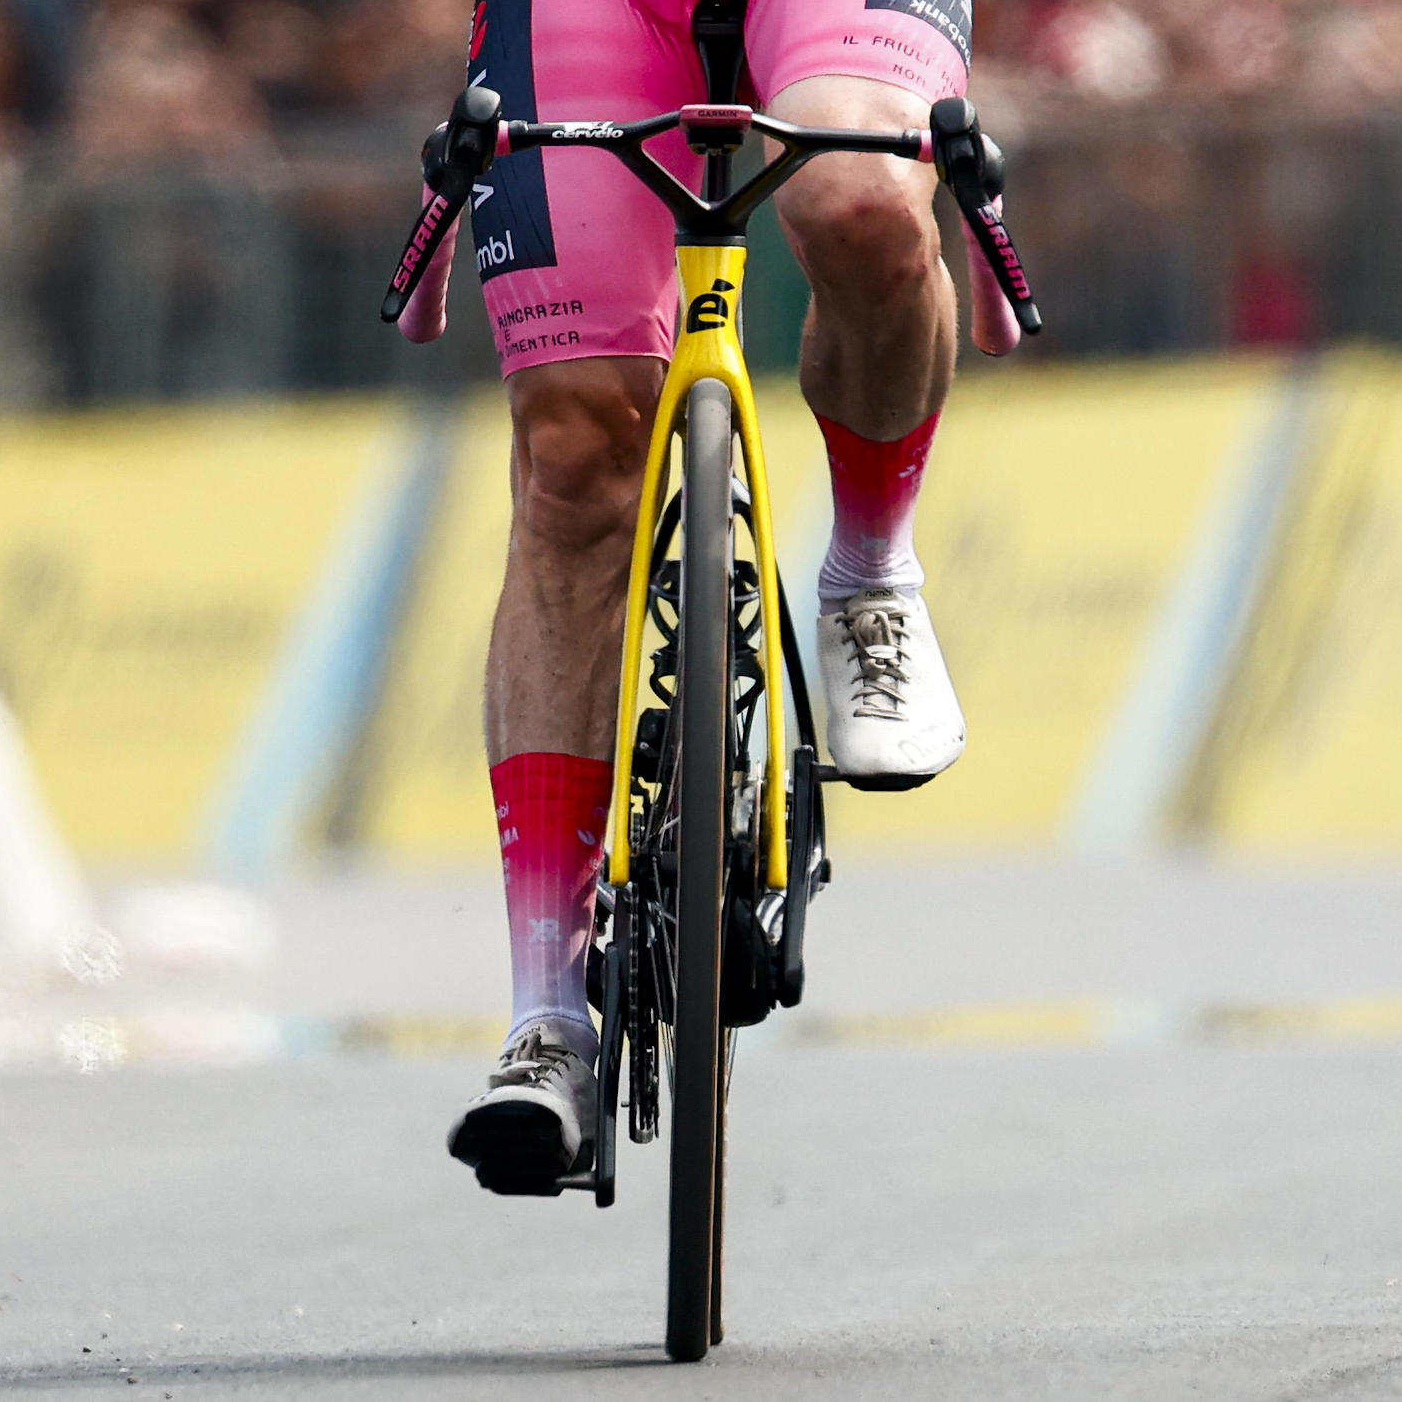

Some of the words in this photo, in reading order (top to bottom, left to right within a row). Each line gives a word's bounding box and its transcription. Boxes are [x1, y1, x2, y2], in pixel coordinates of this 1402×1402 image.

[842, 35, 859, 45] IL
[872, 36, 930, 67] FRIULI
[697, 109, 738, 118] GARMIN
[393, 195, 449, 293] SRAM
[477, 230, 515, 272] mbl
[977, 205, 1031, 300] SRAM
[498, 300, 583, 329] RINGRAZIA
[505, 331, 580, 358] MENTICA
